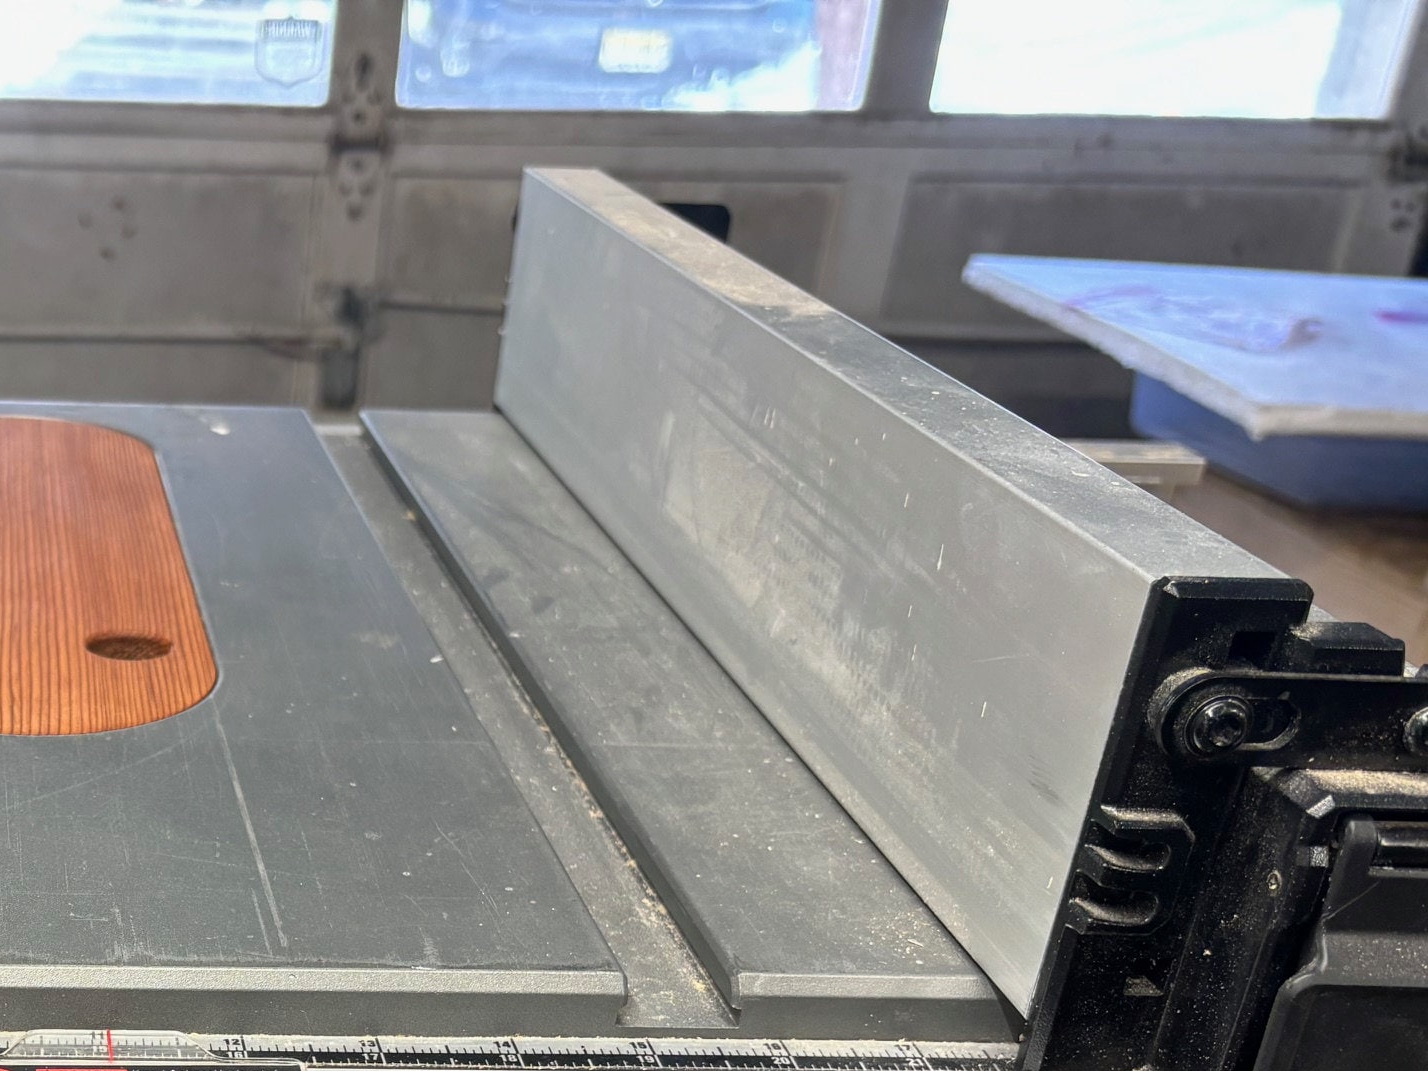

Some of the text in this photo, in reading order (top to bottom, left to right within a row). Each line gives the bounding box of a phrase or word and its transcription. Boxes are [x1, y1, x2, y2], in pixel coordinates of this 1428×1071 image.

[89, 1031, 104, 1040] 11
[223, 1038, 240, 1046] 12
[493, 1041, 511, 1049] 14
[629, 1041, 647, 1049] 15
[226, 1051, 244, 1059] 16
[362, 1053, 378, 1061] 17
[499, 1054, 517, 1063] 18
[636, 1055, 655, 1063] 19
[770, 1056, 790, 1065] 20
